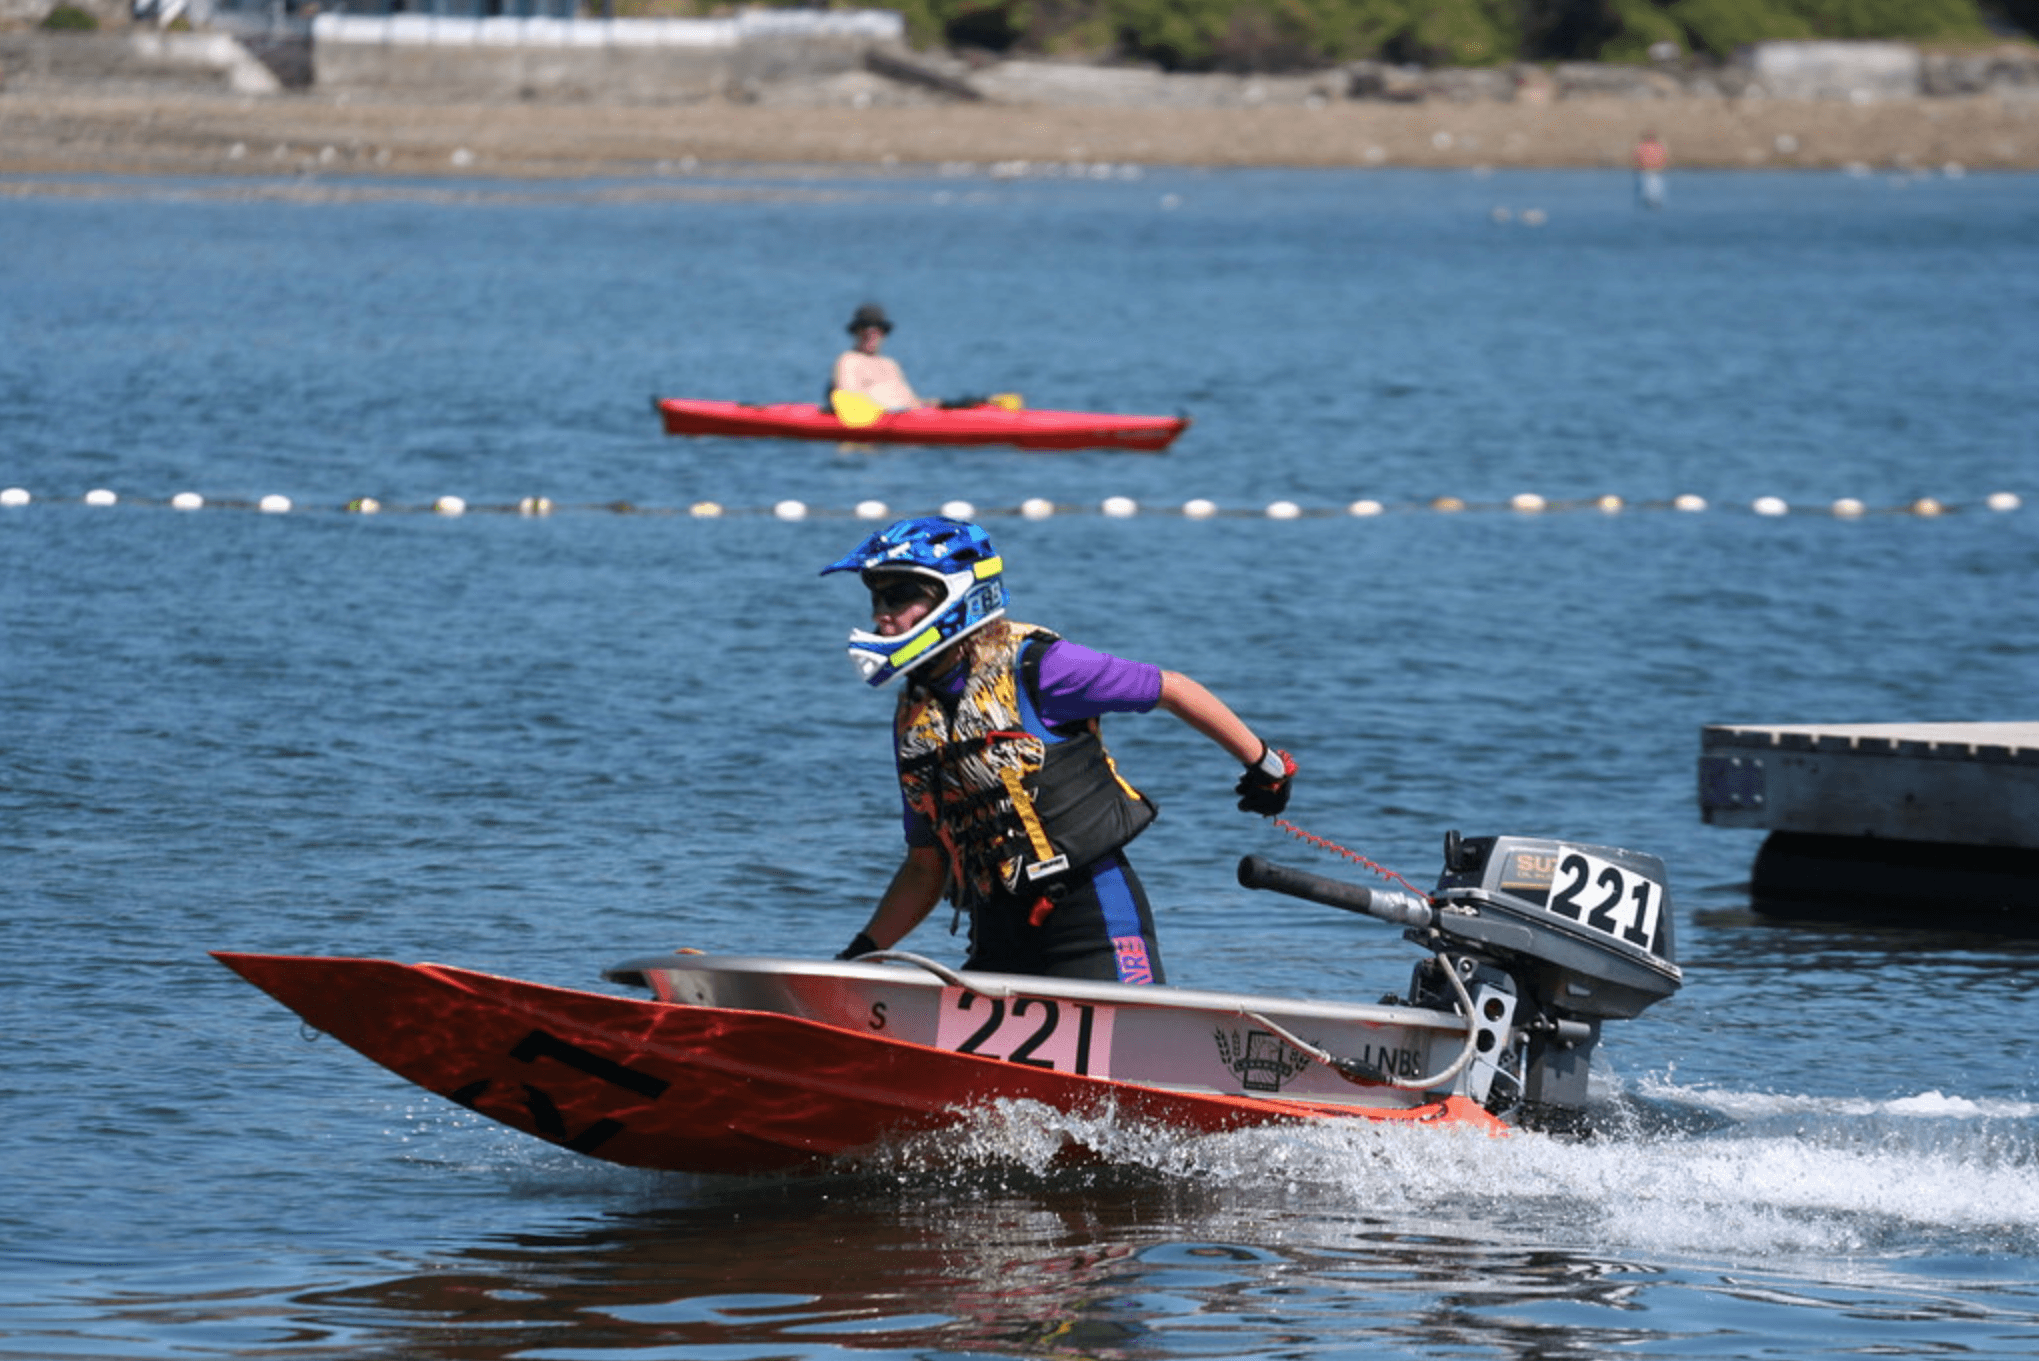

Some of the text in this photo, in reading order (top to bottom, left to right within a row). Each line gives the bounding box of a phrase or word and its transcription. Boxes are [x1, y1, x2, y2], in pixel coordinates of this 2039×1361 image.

[1550, 854, 1651, 948] 221
[868, 1001, 888, 1030] S
[955, 991, 1094, 1077] 221
